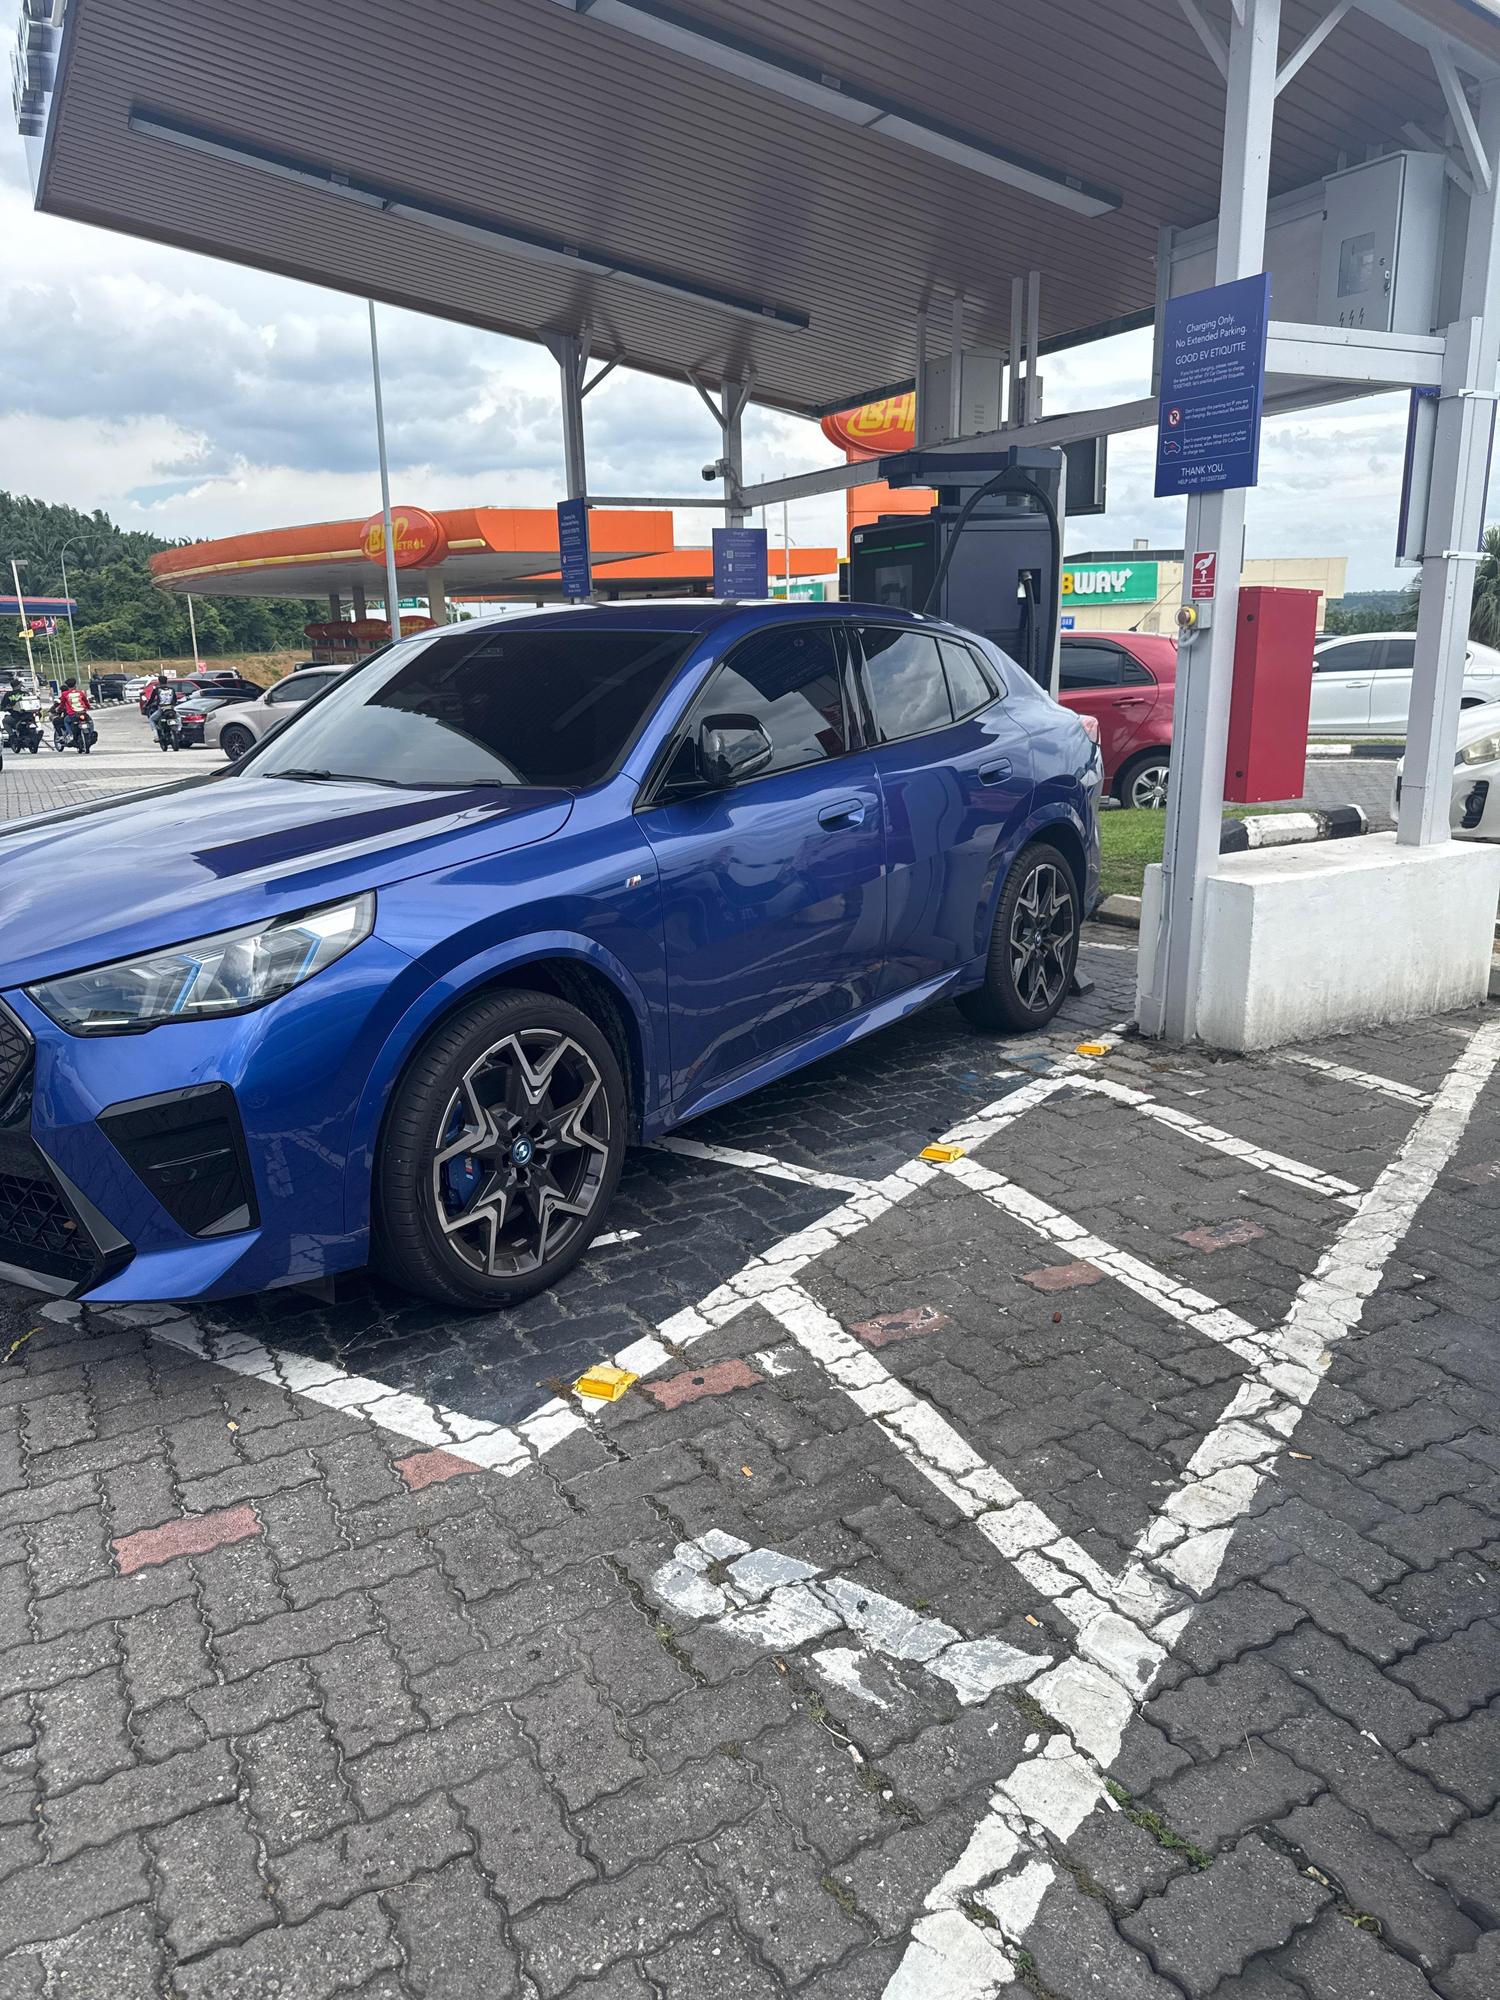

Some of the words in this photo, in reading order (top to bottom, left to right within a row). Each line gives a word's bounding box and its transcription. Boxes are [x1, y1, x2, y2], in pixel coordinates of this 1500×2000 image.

[1186, 320, 1216, 333] Charging
[1218, 314, 1235, 326] Only.
[1176, 339, 1185, 348] No
[1187, 330, 1218, 345] Extended
[1220, 326, 1247, 338] Parking.
[1176, 353, 1198, 365] GOOD
[1200, 350, 1210, 360] EV
[1211, 341, 1246, 356] ETIQUTTE
[1181, 465, 1206, 476] THANK
[1207, 463, 1225, 473] YOU.
